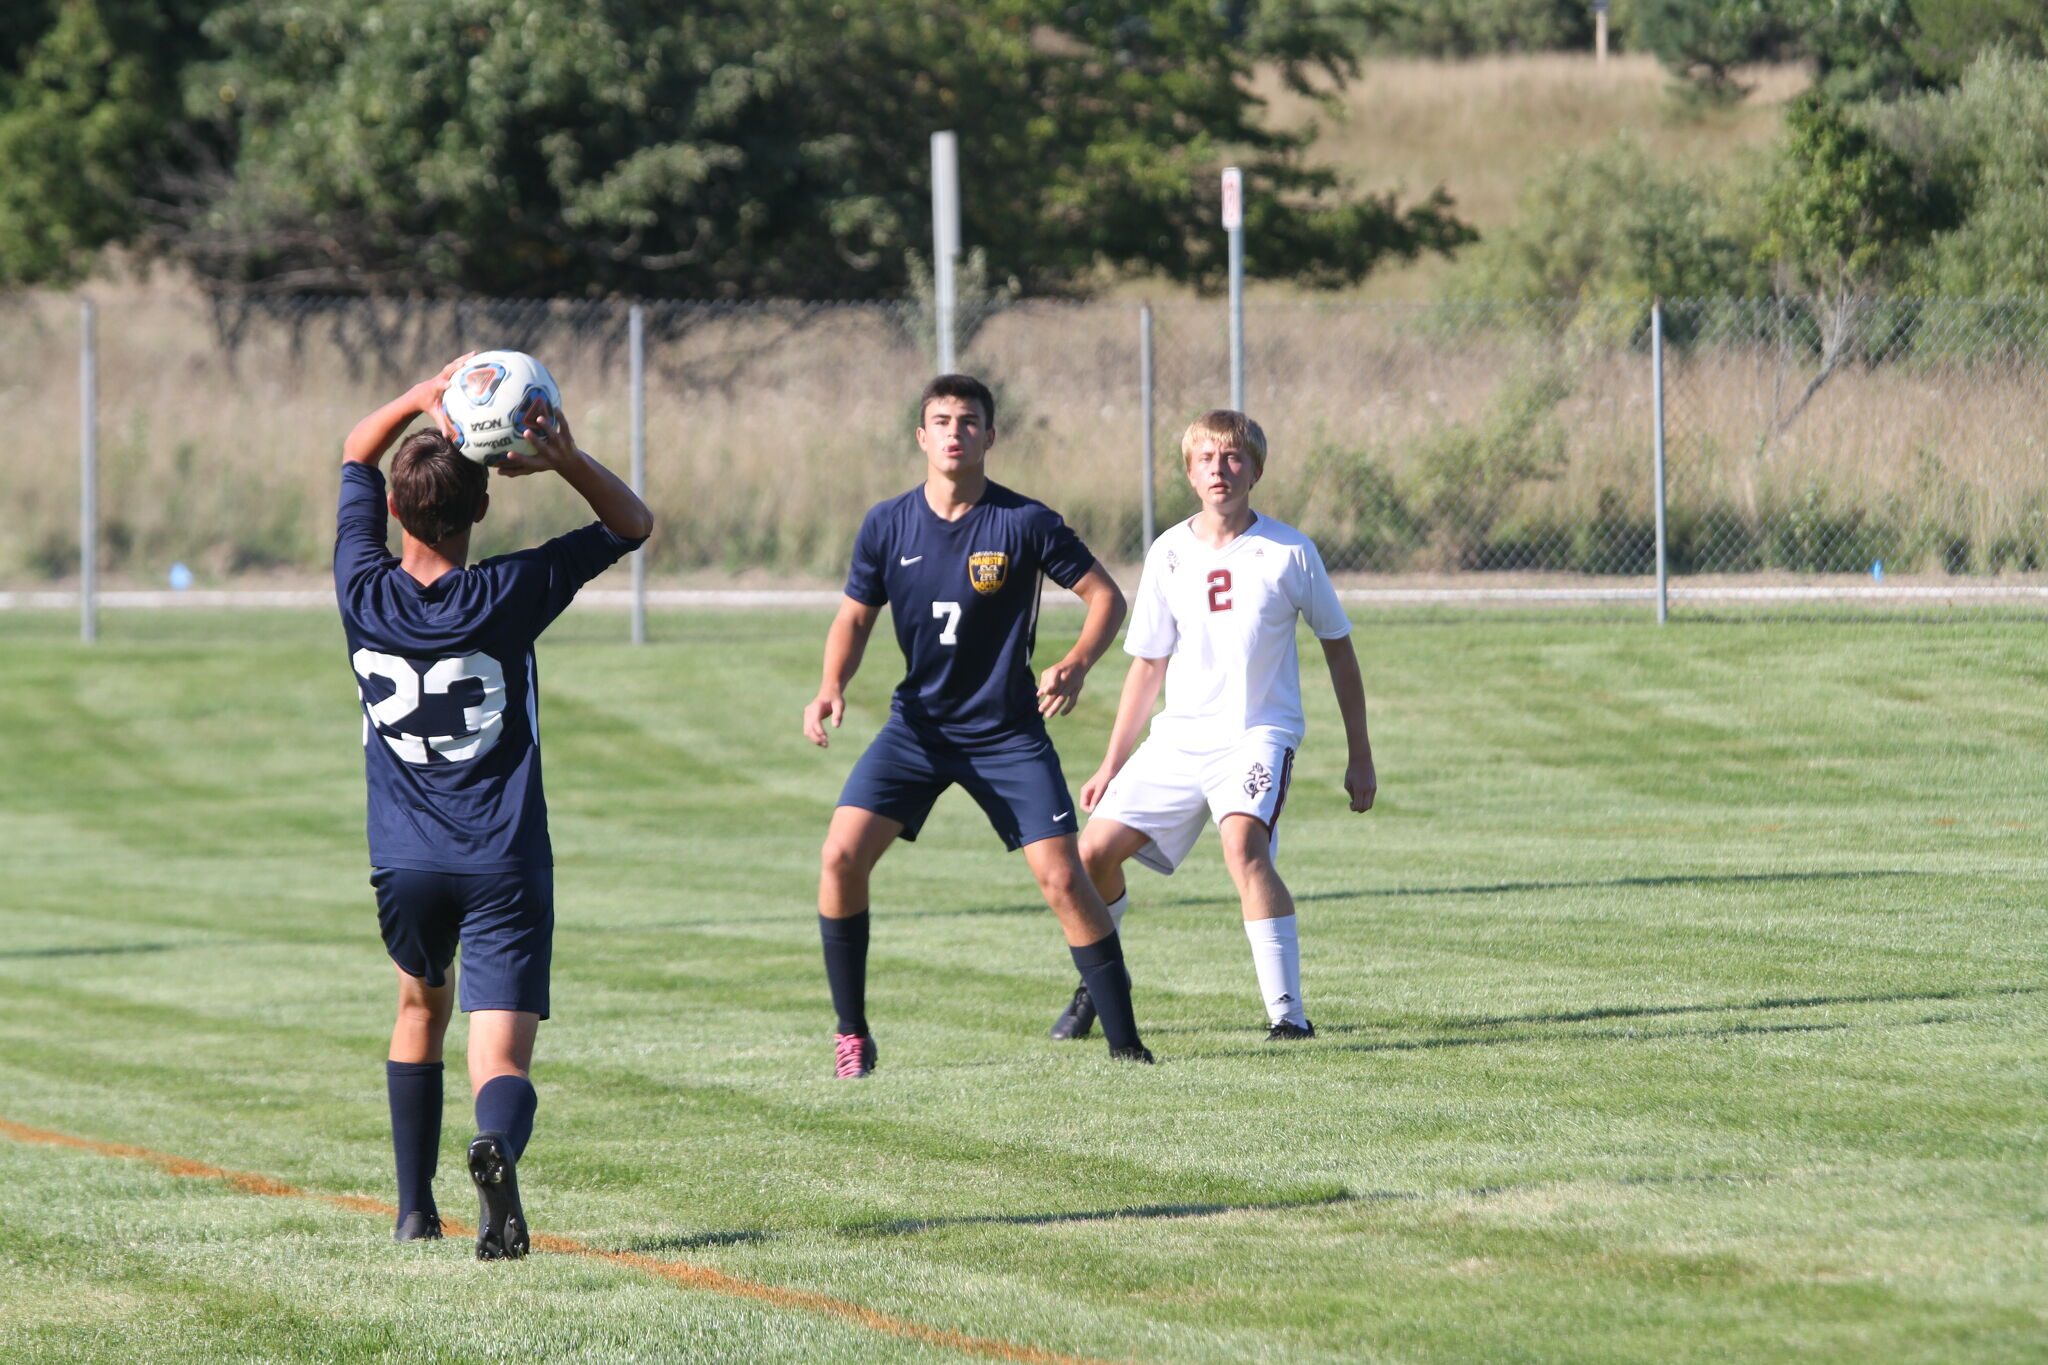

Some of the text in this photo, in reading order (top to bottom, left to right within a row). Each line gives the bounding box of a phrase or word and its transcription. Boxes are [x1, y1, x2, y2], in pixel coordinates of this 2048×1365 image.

[471, 418, 502, 431] NCAA
[1207, 569, 1232, 612] 2
[932, 601, 962, 645] 7
[353, 648, 507, 763] 23
